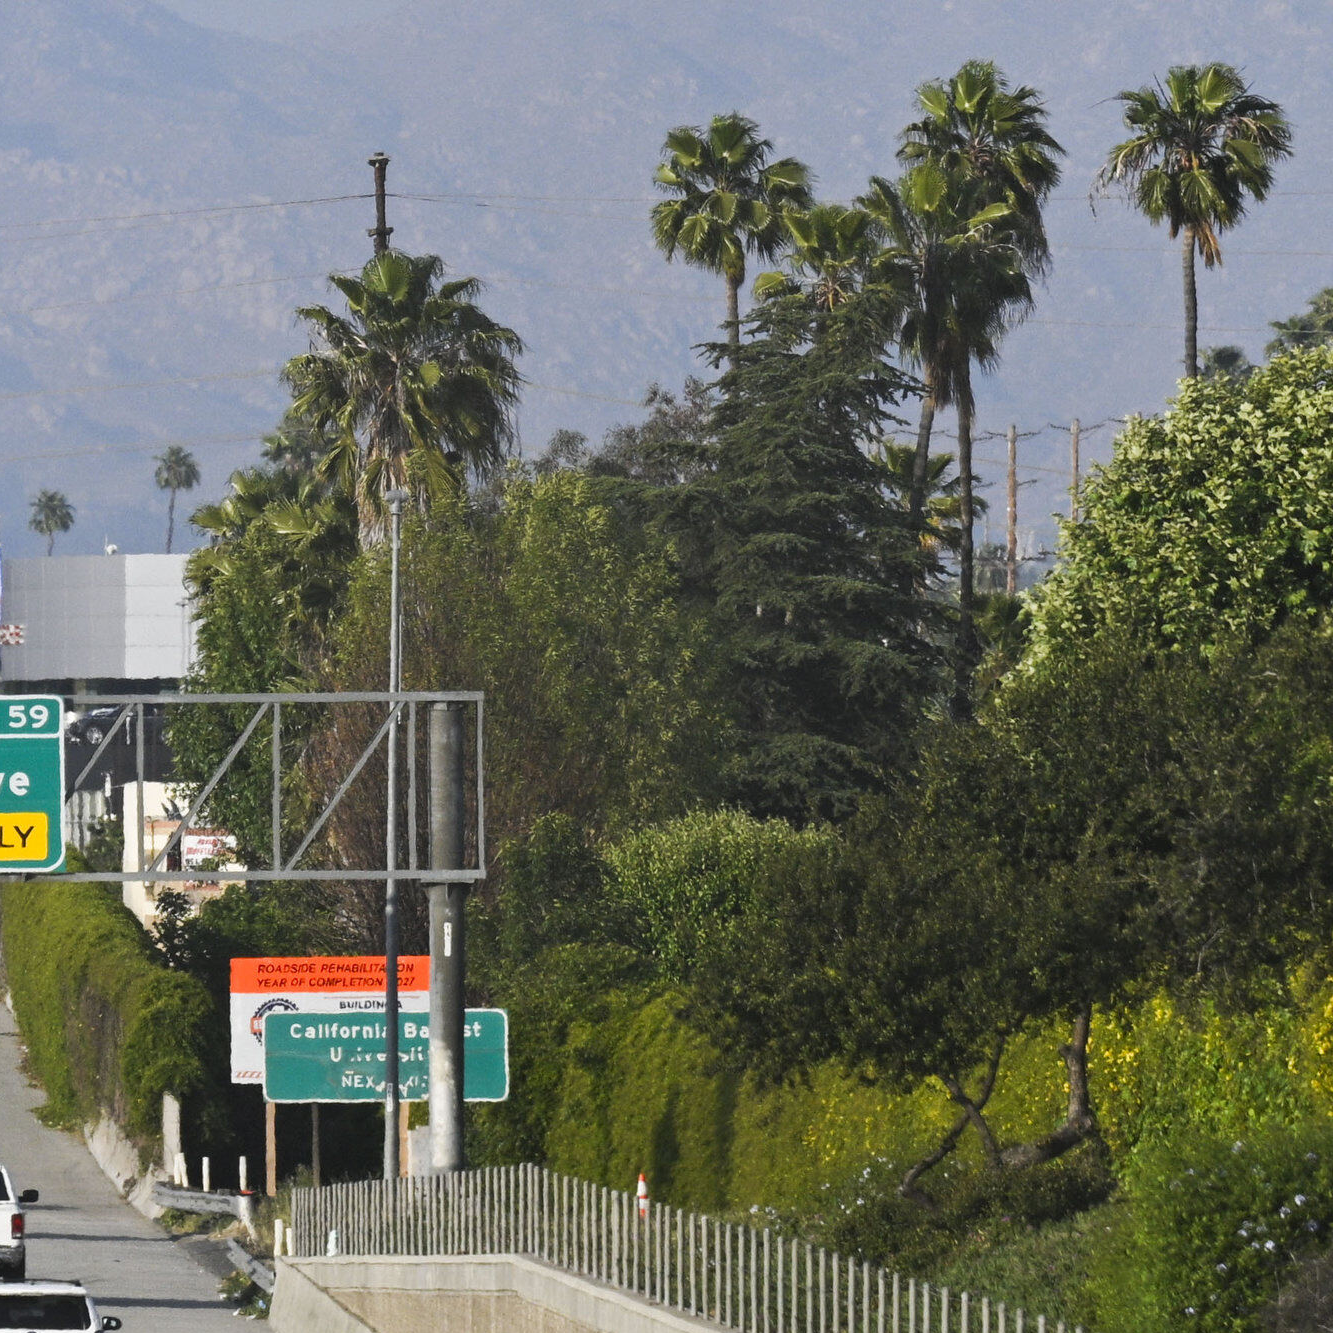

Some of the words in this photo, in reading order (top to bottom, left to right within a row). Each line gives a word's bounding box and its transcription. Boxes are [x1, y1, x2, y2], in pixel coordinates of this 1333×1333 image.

[7, 705, 49, 729] 59
[257, 963, 317, 975] ROADSIDE
[319, 962, 416, 975] REHABILITAON
[256, 977, 288, 988] YEAR
[290, 976, 306, 987] OF
[308, 977, 384, 989] COMPLETION
[339, 1000, 386, 1010] BUILDIN
[290, 1022, 387, 1040] California
[403, 1021, 482, 1040] Bast
[341, 1074, 379, 1090] NEX
